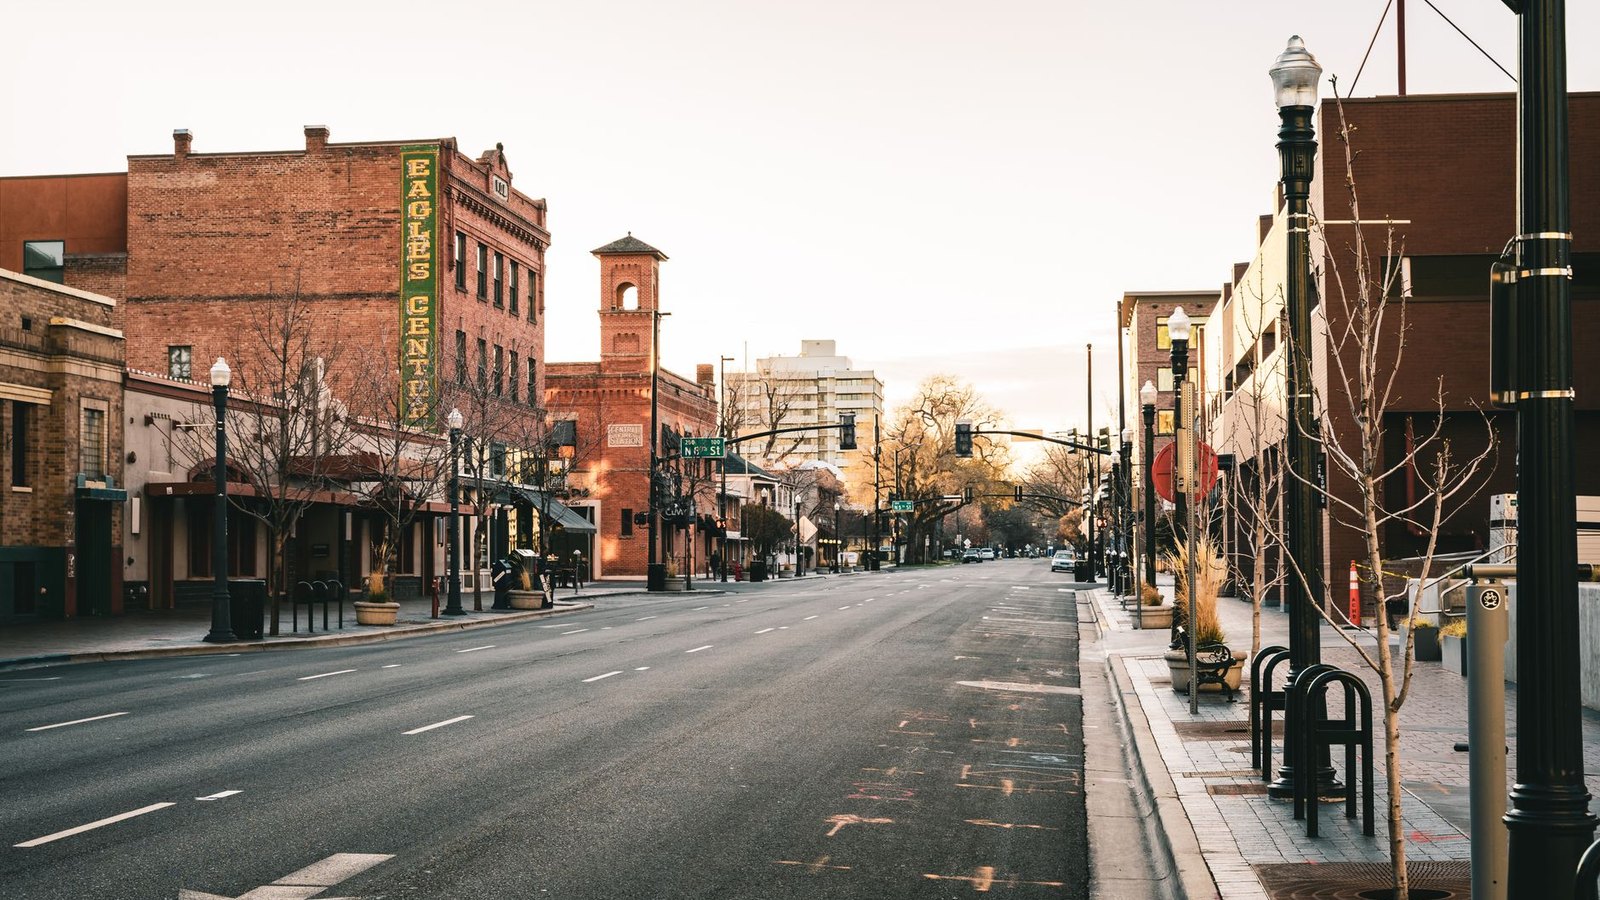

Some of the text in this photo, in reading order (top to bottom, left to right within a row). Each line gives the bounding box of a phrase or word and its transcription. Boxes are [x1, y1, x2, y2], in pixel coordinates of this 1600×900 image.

[406, 158, 432, 281] EAGLES
[684, 446, 691, 456] N
[710, 446, 720, 455] St
